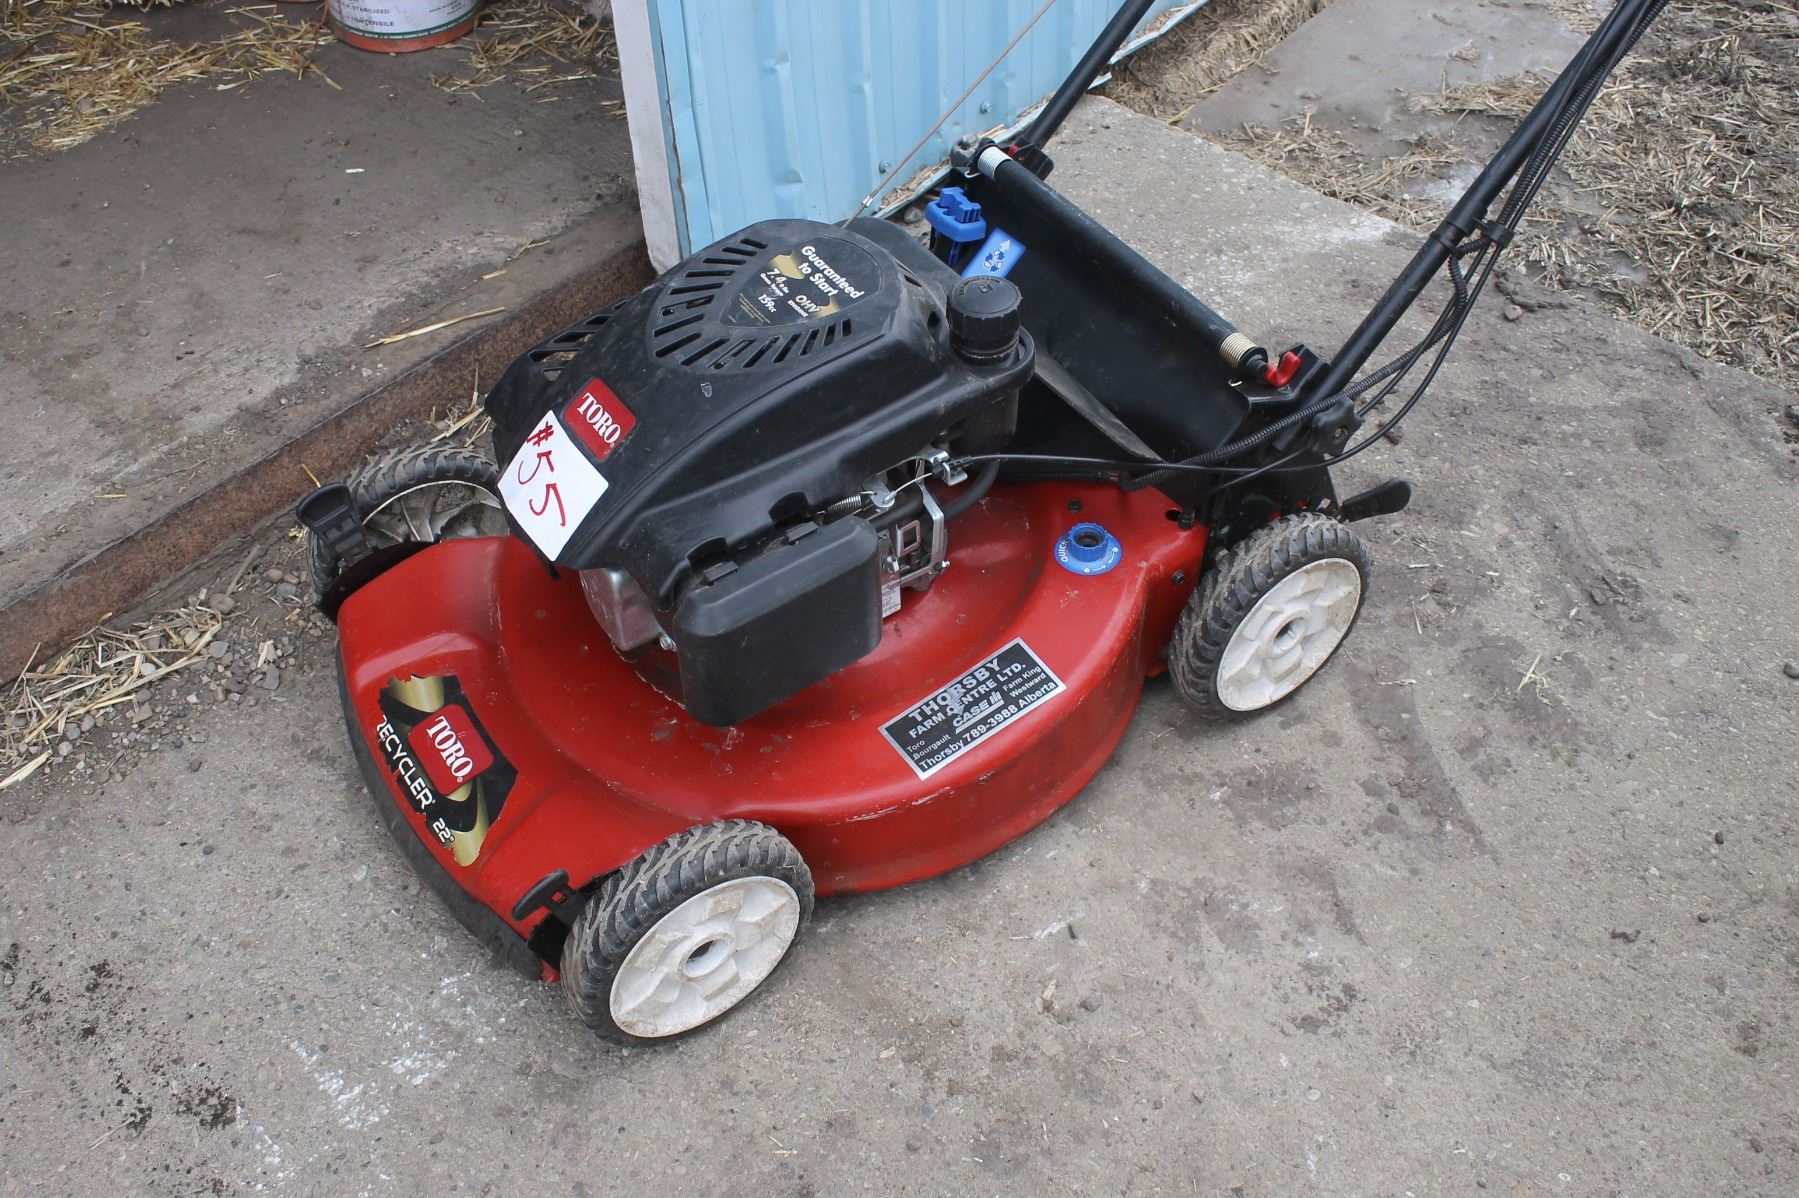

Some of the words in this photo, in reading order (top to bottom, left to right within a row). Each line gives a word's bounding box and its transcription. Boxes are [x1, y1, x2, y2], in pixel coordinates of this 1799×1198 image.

[766, 267, 787, 284] 7.4
[798, 262, 812, 275] to
[809, 272, 838, 297] Start
[801, 245, 865, 299] Guaranteed
[758, 294, 777, 313] 159cc
[795, 295, 821, 313] OHV
[577, 392, 621, 444] TORO
[908, 657, 1001, 723] THORSBY
[1002, 675, 1023, 692] Farm
[1022, 665, 1043, 680] King
[1009, 672, 1047, 699] Westward
[908, 713, 946, 739] FARM
[996, 662, 1026, 682] LTD.
[952, 699, 989, 728] CASE
[918, 739, 965, 771] Thorsby
[963, 704, 1018, 743] 789-3988
[1018, 681, 1057, 709] Alberta
[426, 715, 474, 777] TORO
[906, 739, 926, 754] Toro
[912, 733, 952, 760] Bourgault
